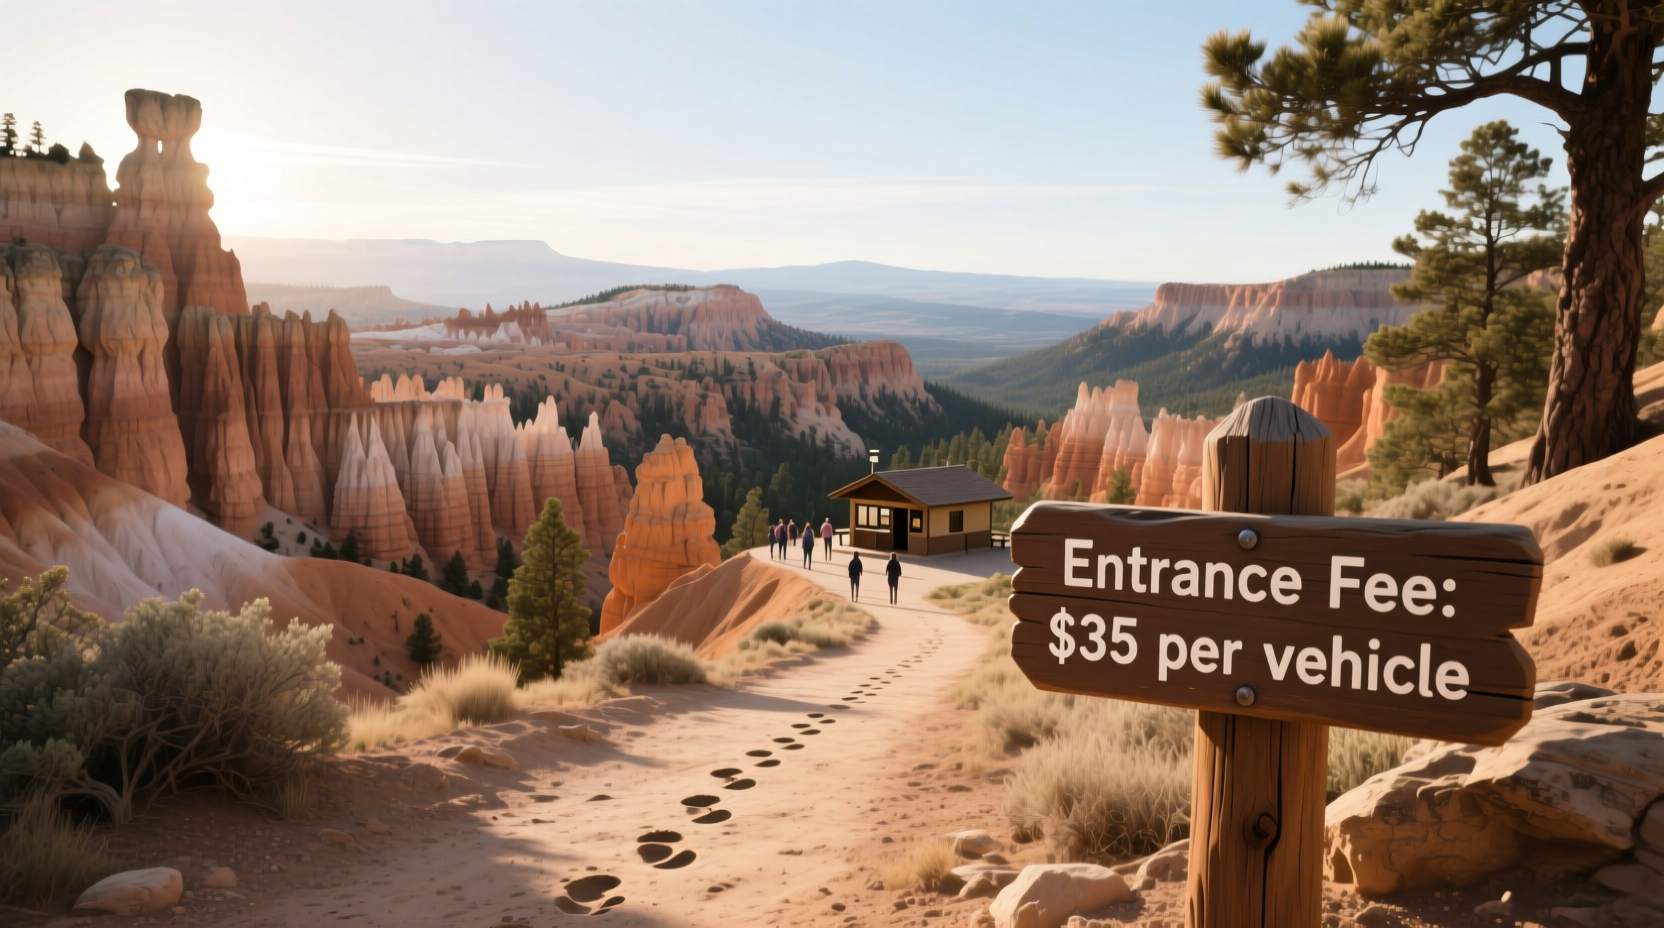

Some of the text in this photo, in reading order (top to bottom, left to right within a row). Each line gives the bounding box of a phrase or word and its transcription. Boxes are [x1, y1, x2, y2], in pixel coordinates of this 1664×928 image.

[1063, 538, 1457, 618] Entrance Fee:
[1048, 606, 1470, 701] $35 per vehicle
